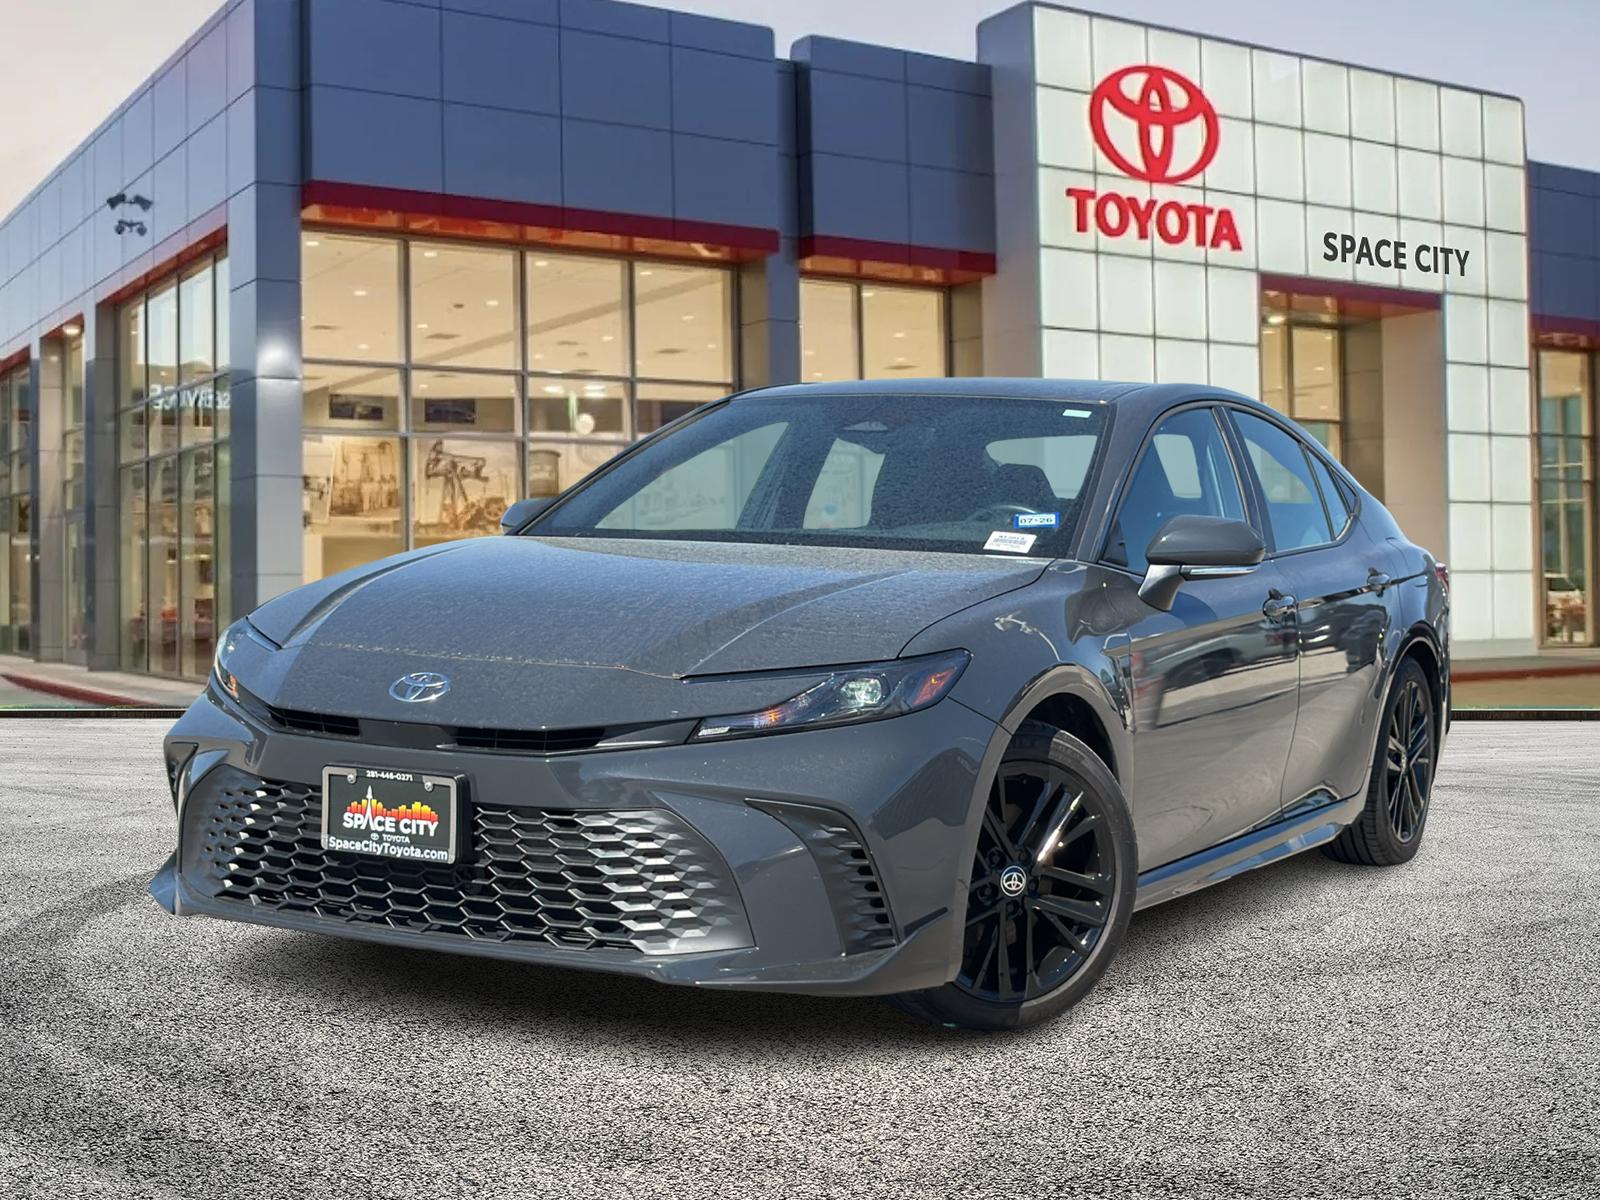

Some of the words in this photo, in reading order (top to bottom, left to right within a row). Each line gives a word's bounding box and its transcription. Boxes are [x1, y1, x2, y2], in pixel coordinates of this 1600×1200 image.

[1066, 187, 1243, 251] TOYOTA
[1323, 231, 1407, 270] SPACE
[1414, 244, 1471, 277] CITY
[1020, 516, 1053, 525] 07-26
[343, 811, 396, 832] SPACE
[400, 818, 439, 837] CITY
[329, 836, 448, 861] SpaceCityToyota.com
[382, 833, 410, 844] TOYOTA
